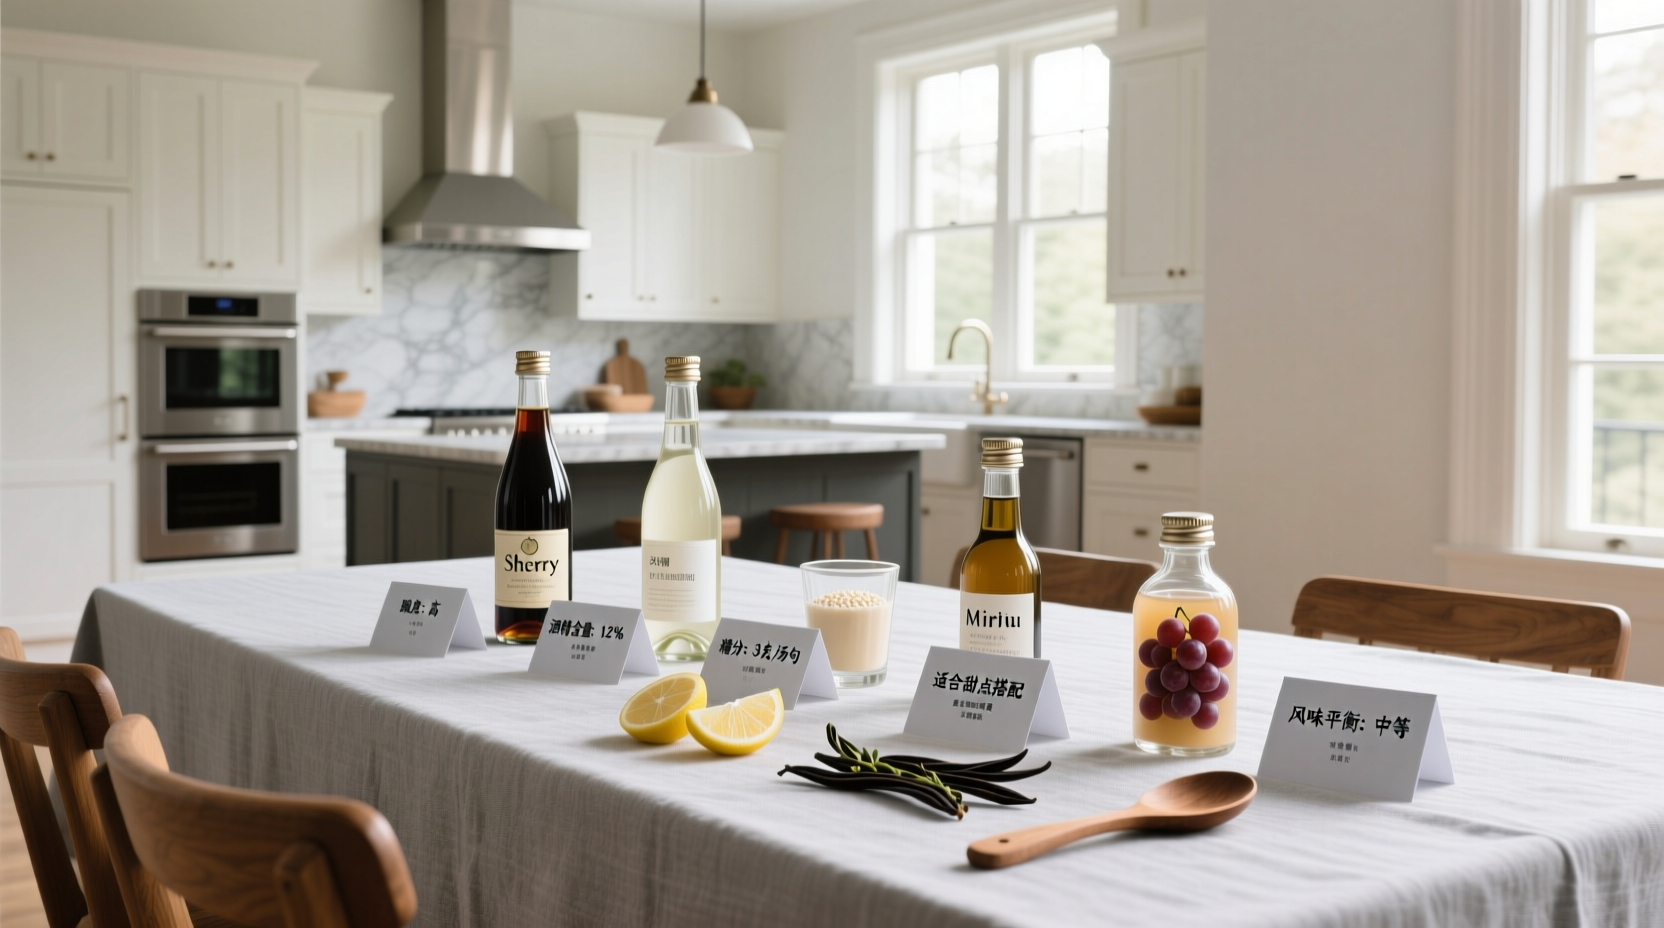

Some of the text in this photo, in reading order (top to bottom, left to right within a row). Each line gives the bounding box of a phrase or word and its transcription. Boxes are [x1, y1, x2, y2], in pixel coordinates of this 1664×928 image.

[504, 554, 559, 577] Sherry
[932, 671, 1025, 700] 适合甜点搭配
